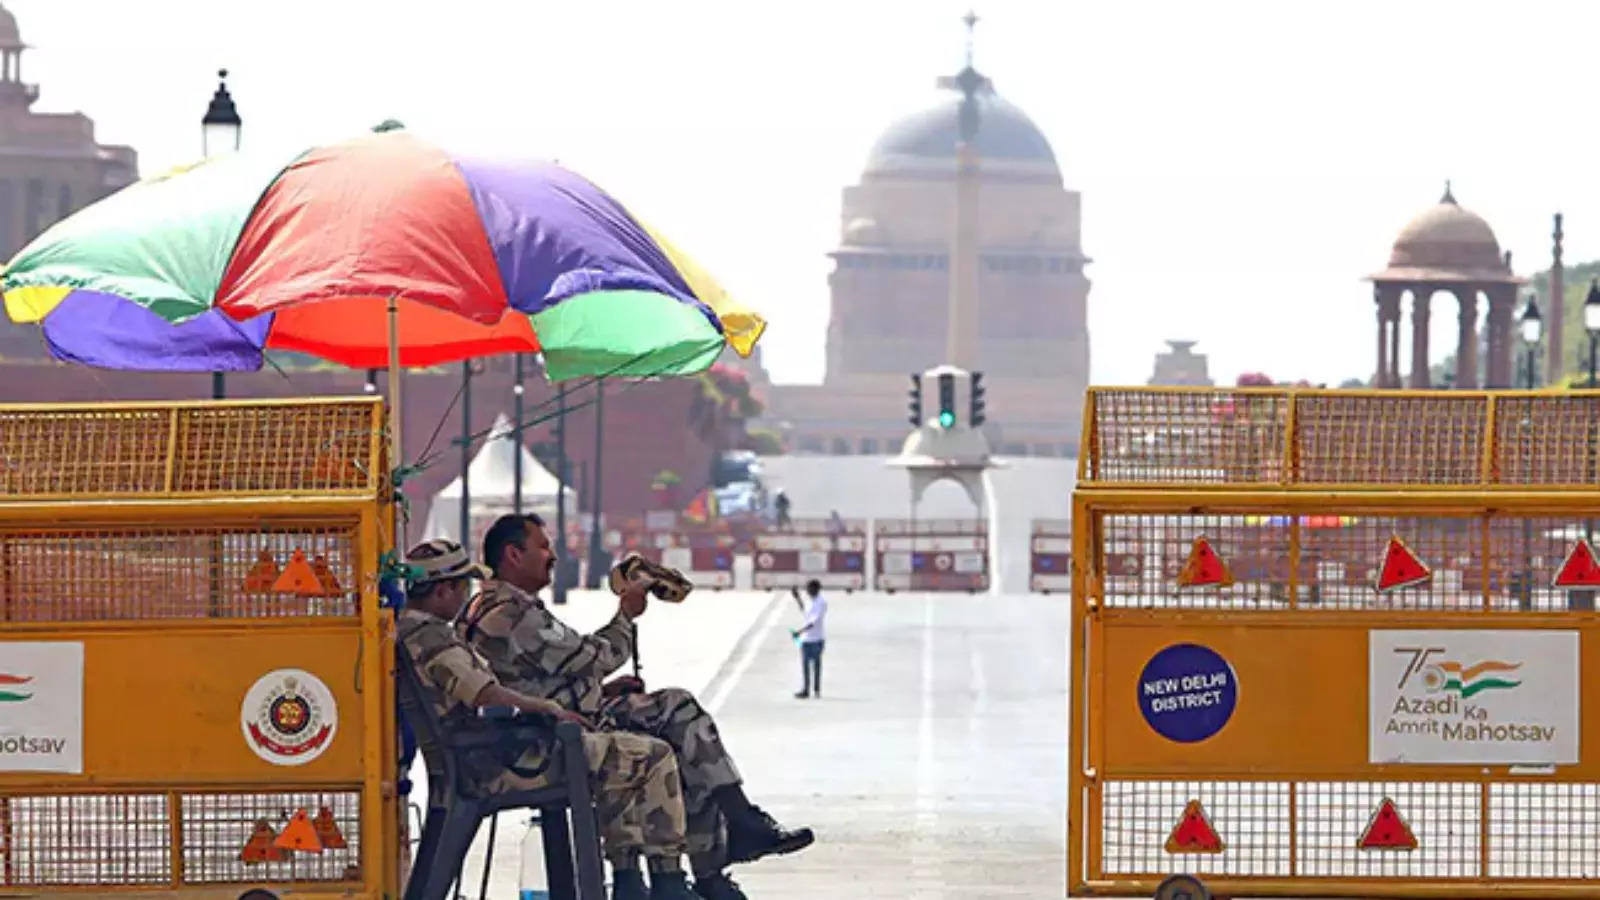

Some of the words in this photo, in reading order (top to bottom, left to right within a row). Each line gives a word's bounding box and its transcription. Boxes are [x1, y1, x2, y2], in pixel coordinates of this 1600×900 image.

[1143, 679, 1179, 695] NEW
[1181, 673, 1226, 691] DELHI
[1152, 691, 1221, 712] DISTRICT
[1393, 694, 1458, 714] Azadi
[1464, 705, 1488, 721] Ka
[1385, 718, 1438, 734] Amrit
[1442, 721, 1556, 741] Mahotsav
[0, 735, 66, 754] otsav
